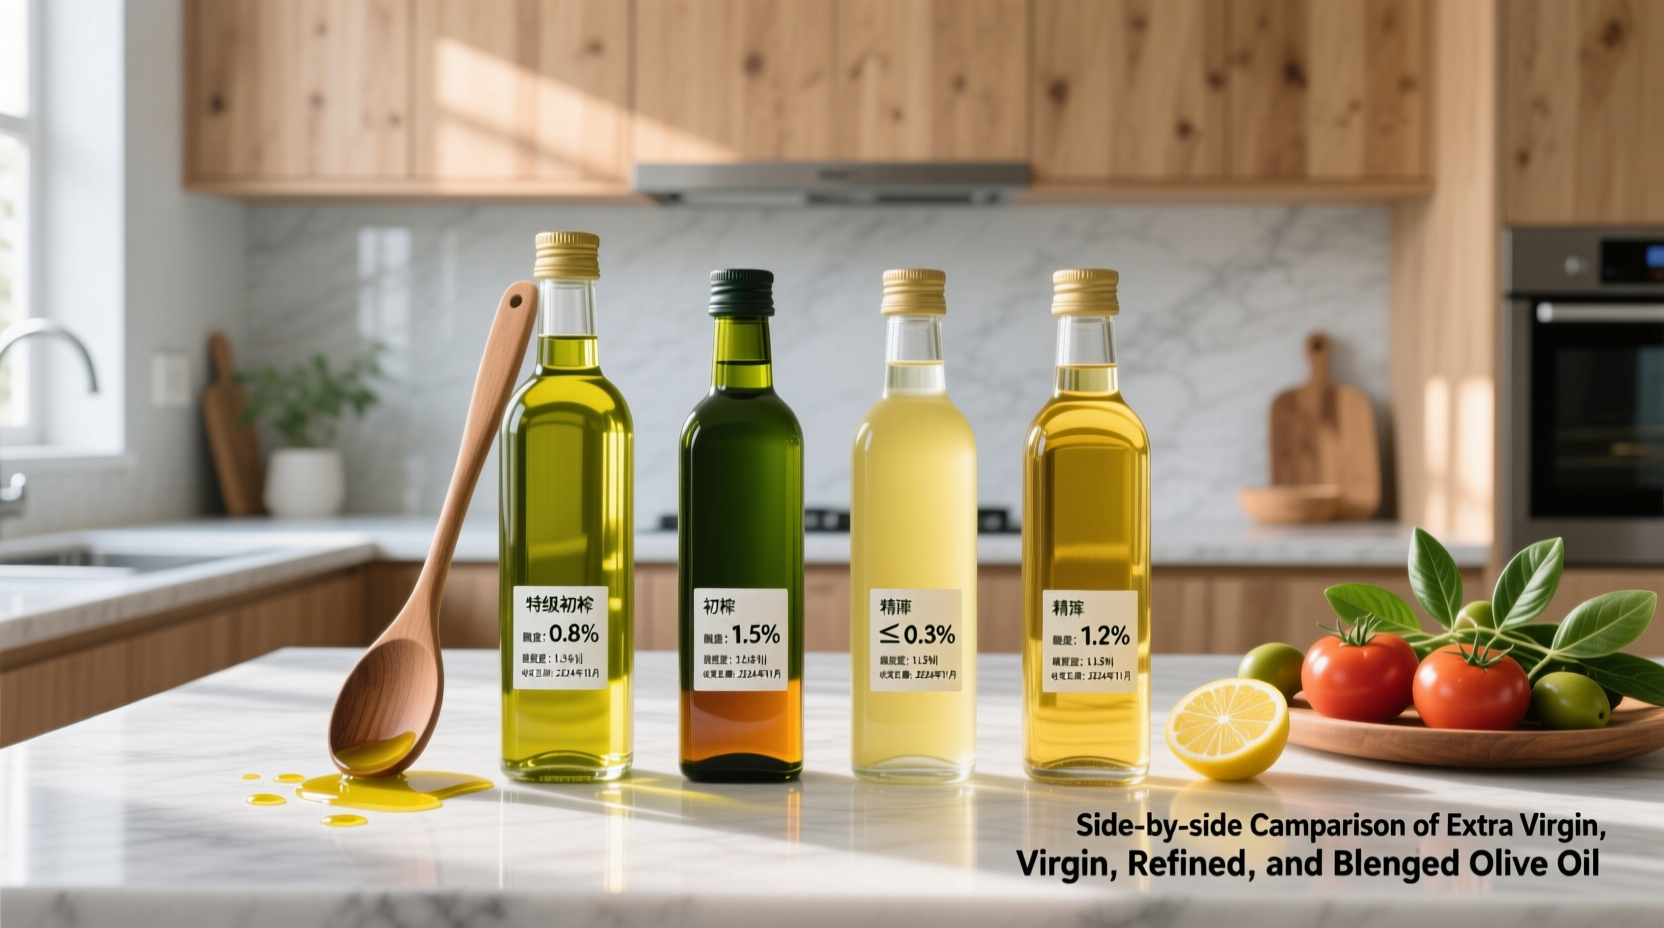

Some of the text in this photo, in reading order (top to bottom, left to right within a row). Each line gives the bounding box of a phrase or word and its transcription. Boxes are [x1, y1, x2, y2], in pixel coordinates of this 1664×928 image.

[549, 623, 600, 643] 0.8%
[732, 623, 781, 644] 1.5%
[1081, 625, 1131, 646] 1.2%
